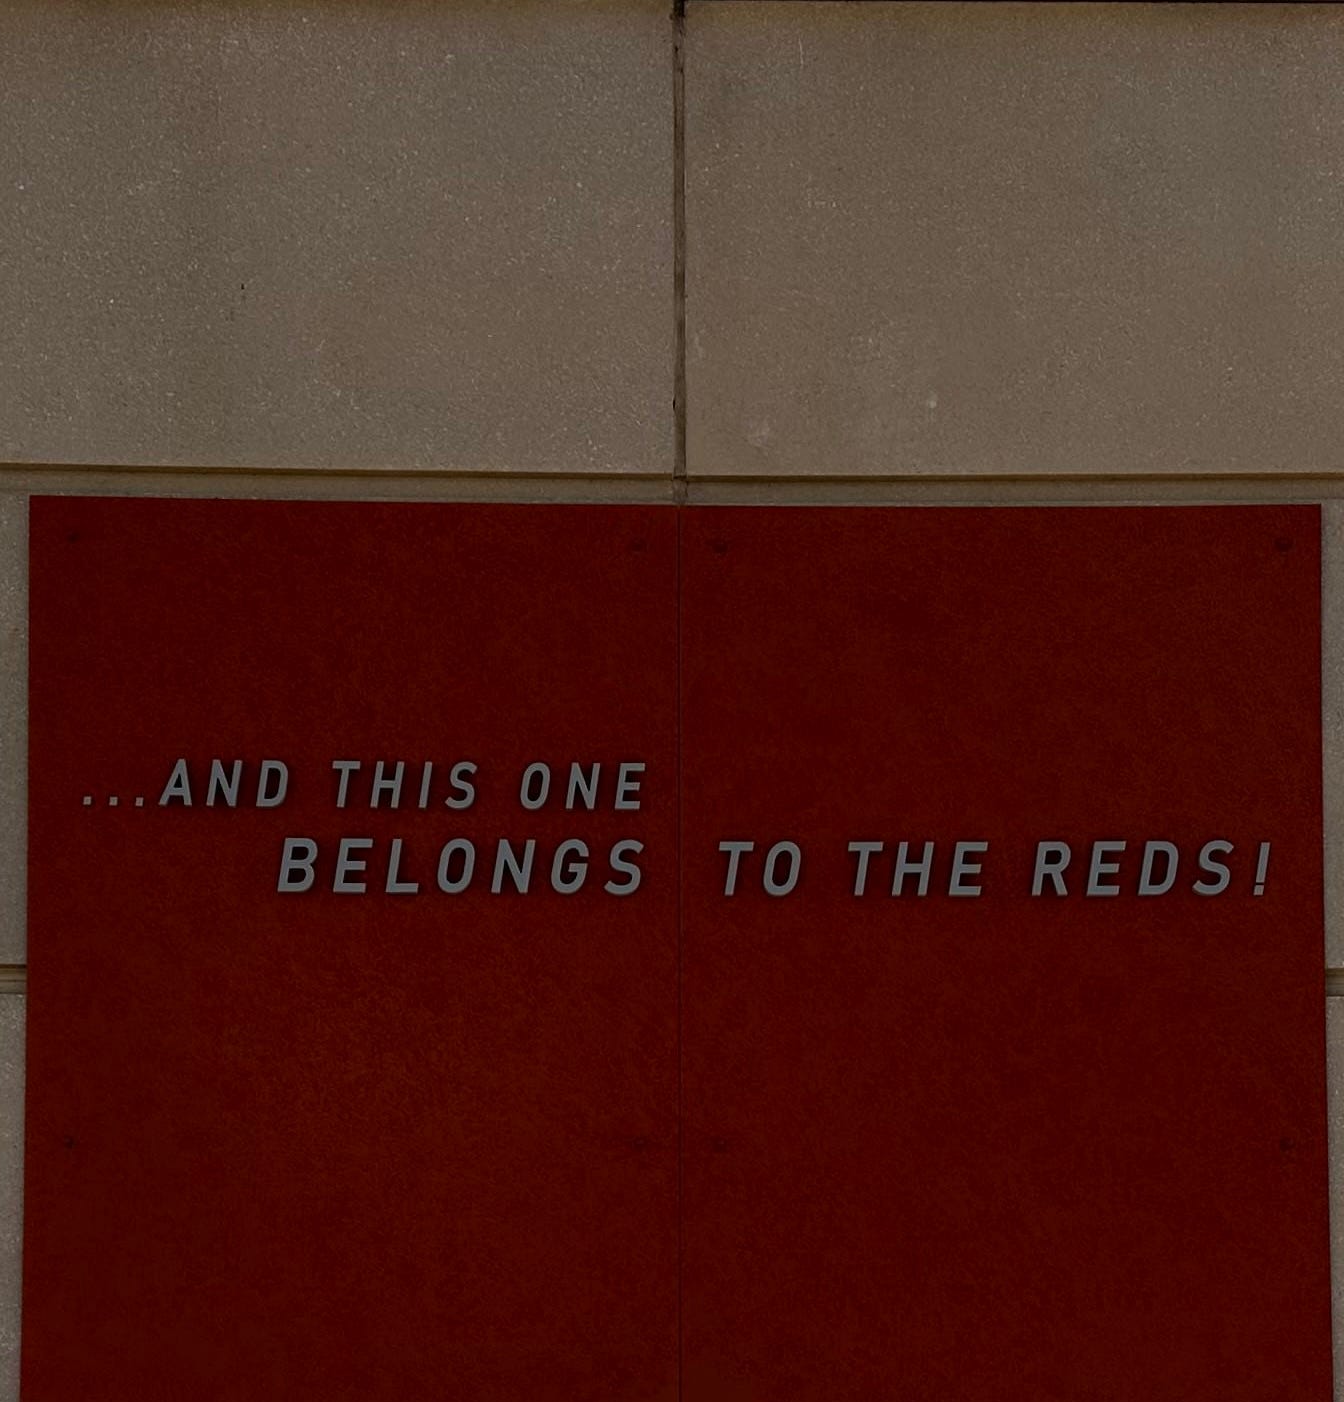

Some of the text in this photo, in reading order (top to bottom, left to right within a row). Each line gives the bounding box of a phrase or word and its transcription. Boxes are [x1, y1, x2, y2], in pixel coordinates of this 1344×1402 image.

[332, 760, 477, 809] THIS
[520, 762, 646, 810] ONE
[276, 837, 1273, 896] BELONGS TO THE REDS!
